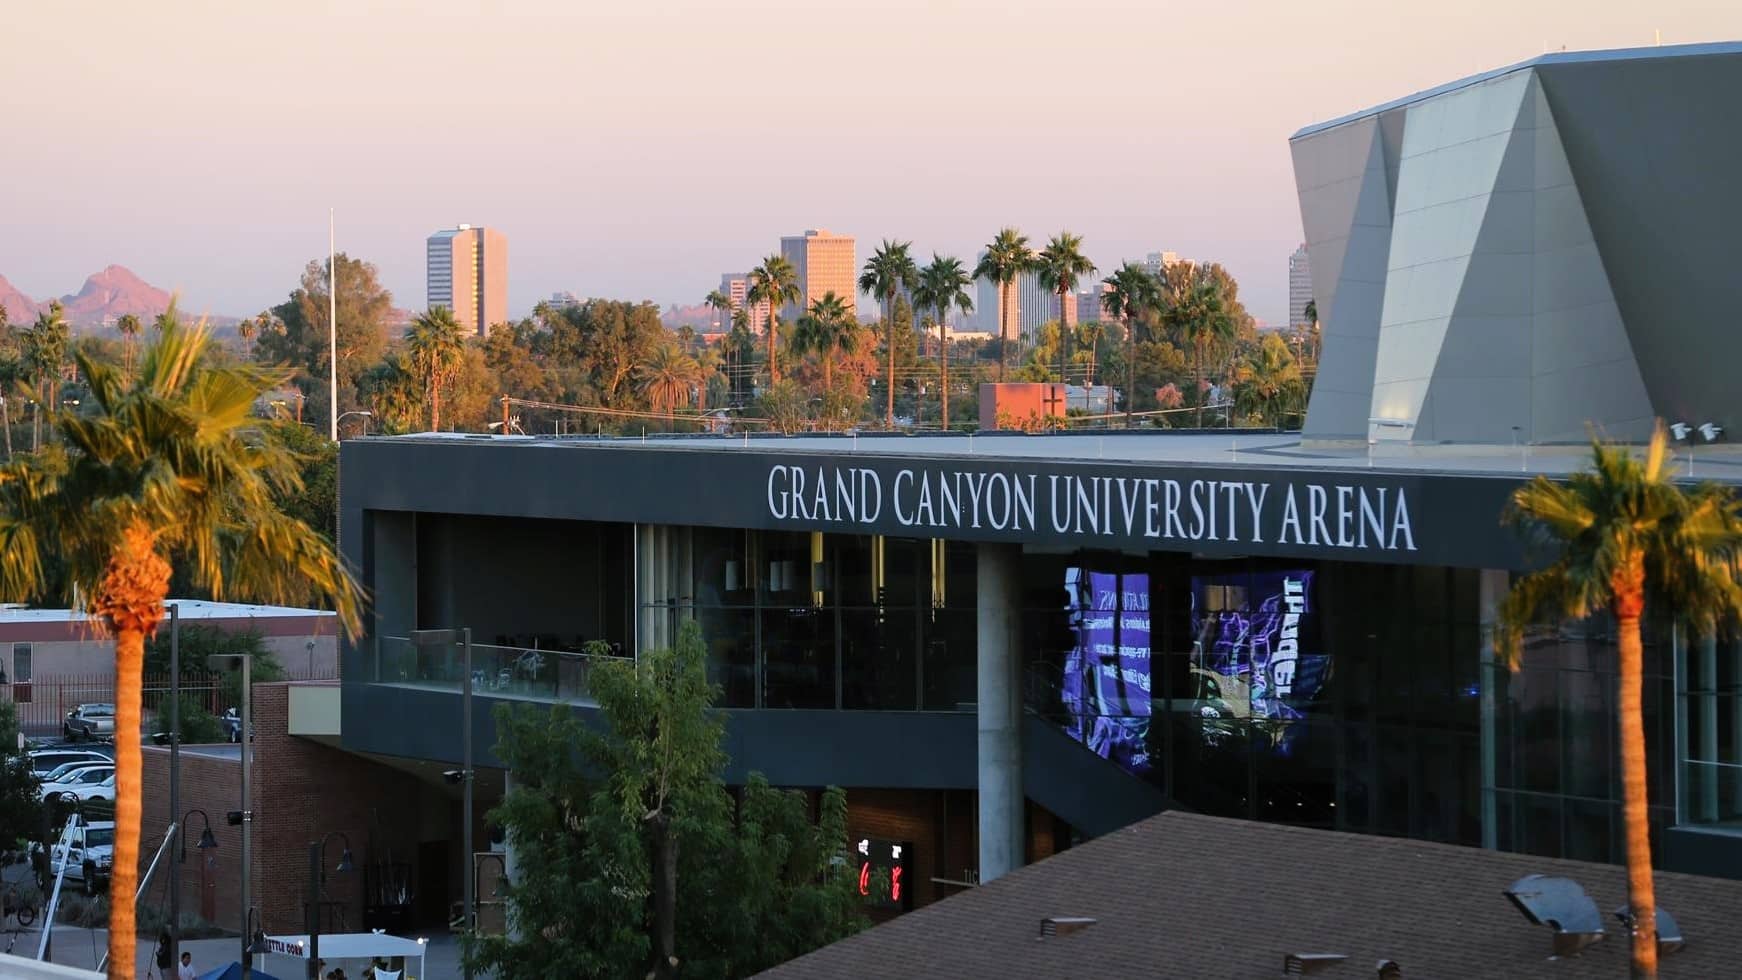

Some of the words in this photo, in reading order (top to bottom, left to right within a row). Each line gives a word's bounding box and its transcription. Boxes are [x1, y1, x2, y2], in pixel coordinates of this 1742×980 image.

[767, 464, 882, 524] GRAND
[893, 469, 1038, 531] CANYON
[1048, 474, 1270, 543] UNIVERSITY
[1277, 483, 1418, 551] ARENA
[286, 943, 304, 957] CORN
